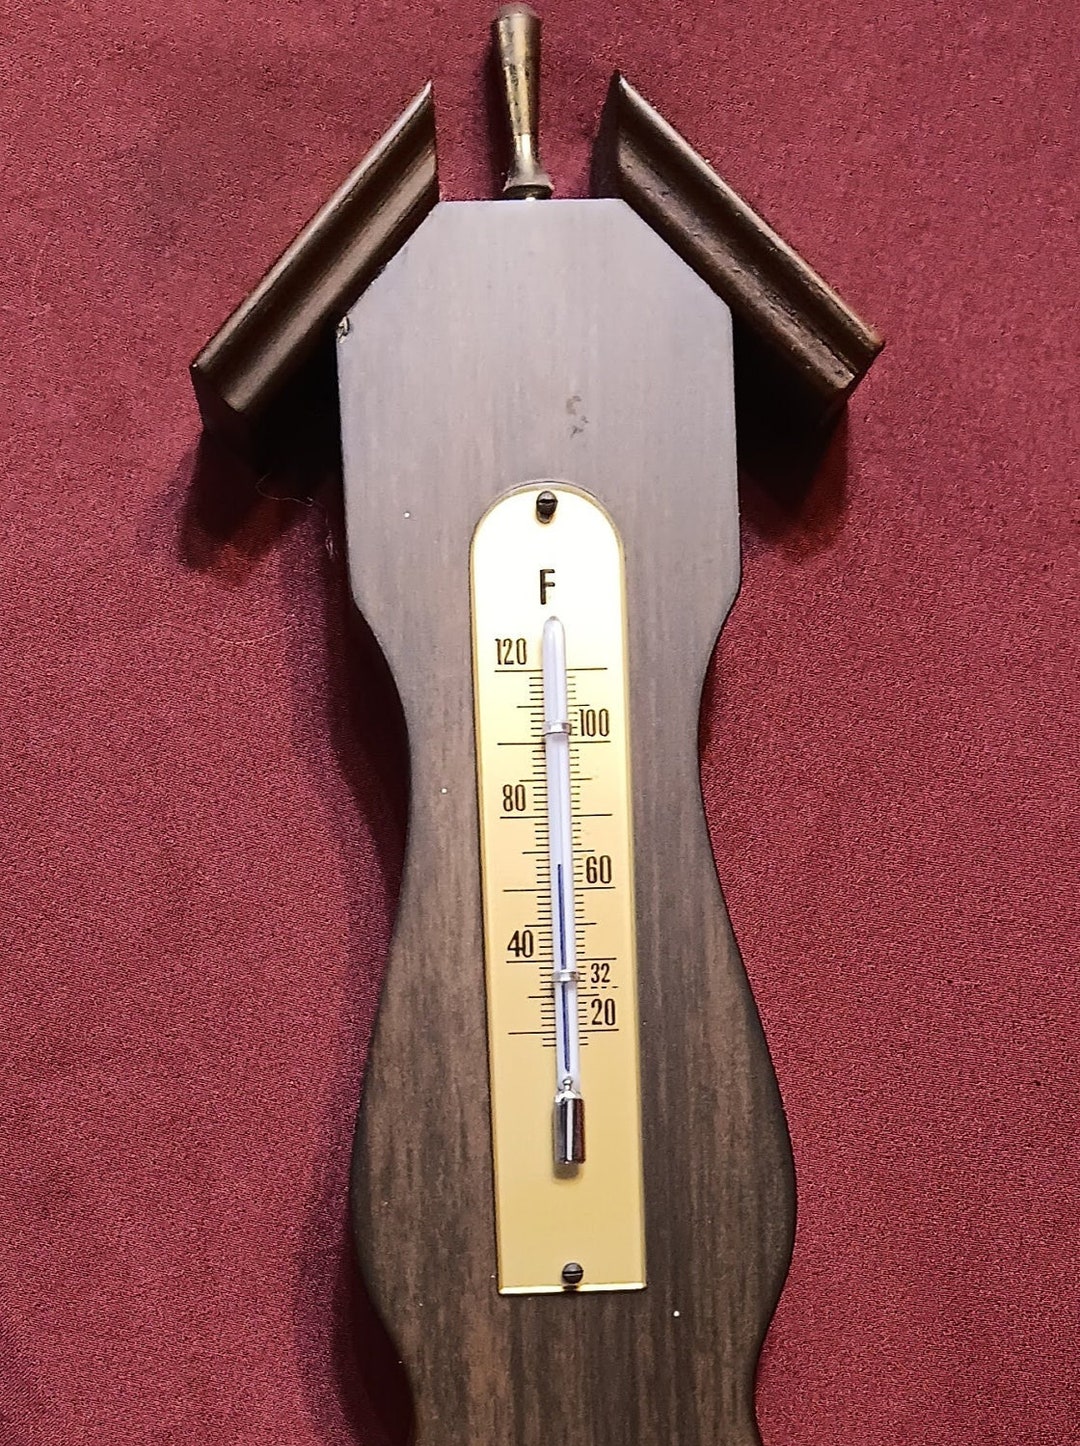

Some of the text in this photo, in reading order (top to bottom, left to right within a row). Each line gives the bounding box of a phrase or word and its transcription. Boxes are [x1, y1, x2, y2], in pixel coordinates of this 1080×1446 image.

[540, 568, 556, 605] F
[495, 638, 527, 665] 120
[579, 708, 609, 737] 100
[503, 784, 526, 812] 80
[586, 854, 612, 884] 60
[507, 930, 534, 959] 40
[590, 963, 611, 983] 32
[590, 998, 616, 1026] 20
